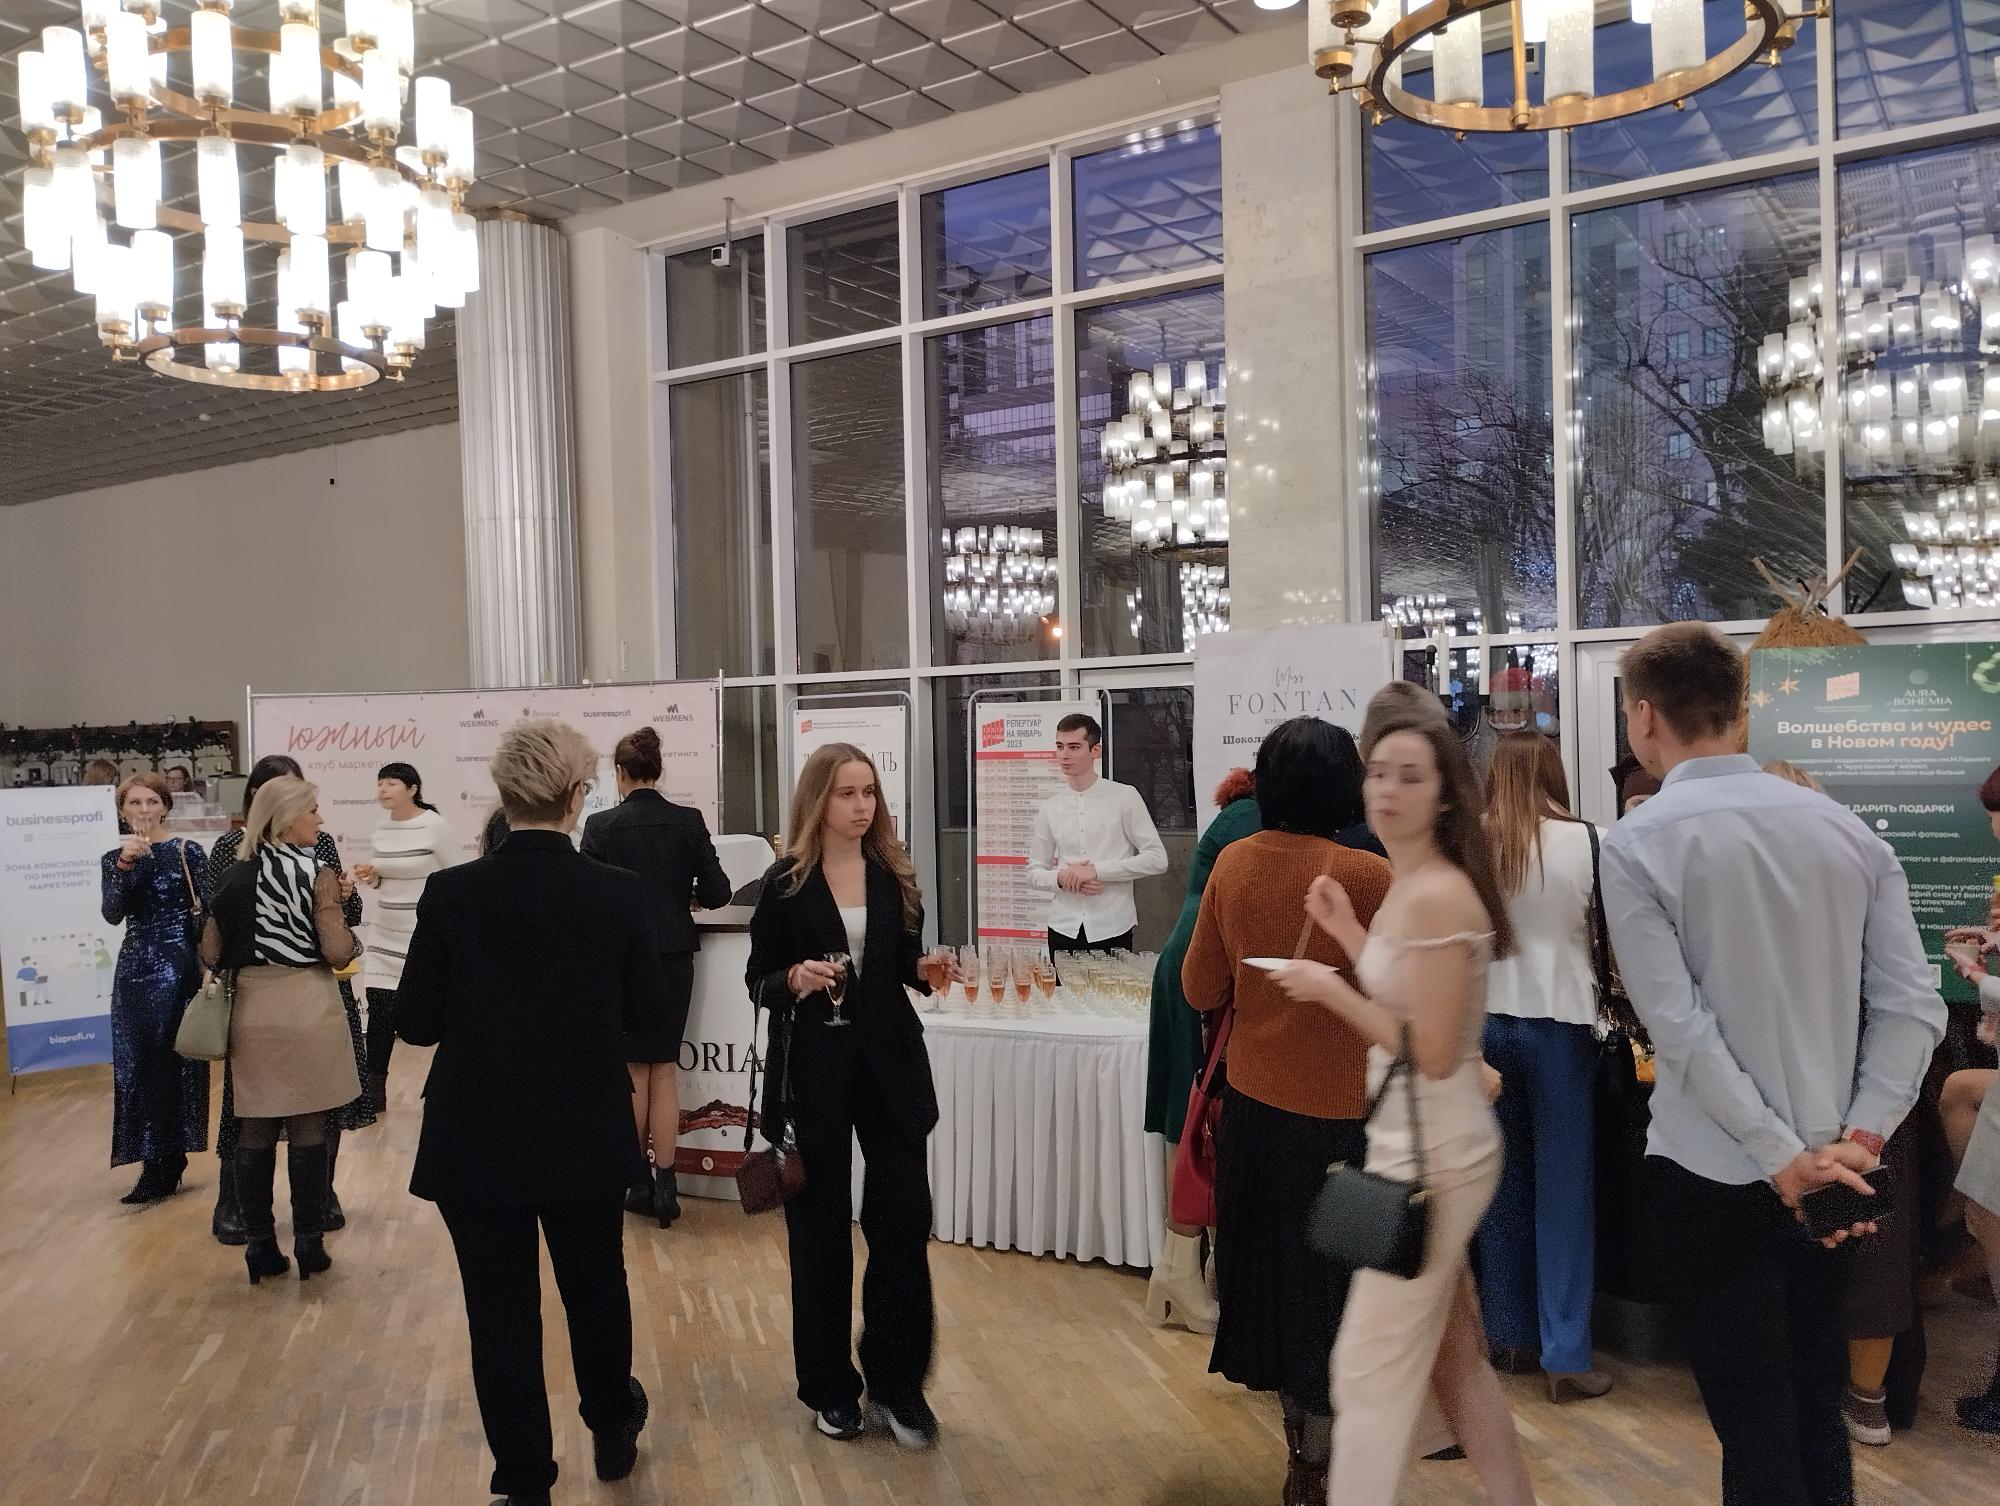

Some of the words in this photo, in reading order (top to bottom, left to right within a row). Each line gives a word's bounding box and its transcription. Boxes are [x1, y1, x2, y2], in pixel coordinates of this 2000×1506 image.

[1904, 689, 1937, 698] AURA
[1228, 688, 1358, 715] FONTAN
[1893, 696, 1953, 706] BOHEMIA
[583, 710, 632, 718] businessprofi
[653, 714, 694, 722] WEBMENS
[459, 719, 499, 728] WEBMENS
[1006, 719, 1042, 728] РЕПЕРТУАР
[1777, 719, 1906, 734] Волшебства
[1911, 720, 1923, 731] и
[1928, 719, 1992, 734] чудес
[287, 718, 426, 752] южный
[1006, 729, 1016, 738] НА
[1016, 728, 1042, 738] ЯНВАРЬ
[1006, 739, 1023, 748] 2023
[1811, 738, 1823, 749] в
[1828, 735, 1895, 749] Новом
[1900, 734, 1955, 750] году!
[308, 759, 335, 773] клуб
[1852, 803, 1897, 814] ДАРИТЬ
[1899, 803, 1955, 814] ПОДАРКИ
[6, 811, 104, 826] businessprofi
[5, 863, 32, 873] ЗОНА
[34, 859, 101, 871] КОНСУЛЬТАЦ
[1960, 884, 1995, 893] участву
[49, 1032, 96, 1045] bizprofi.ru
[676, 1040, 766, 1073] ORIA
